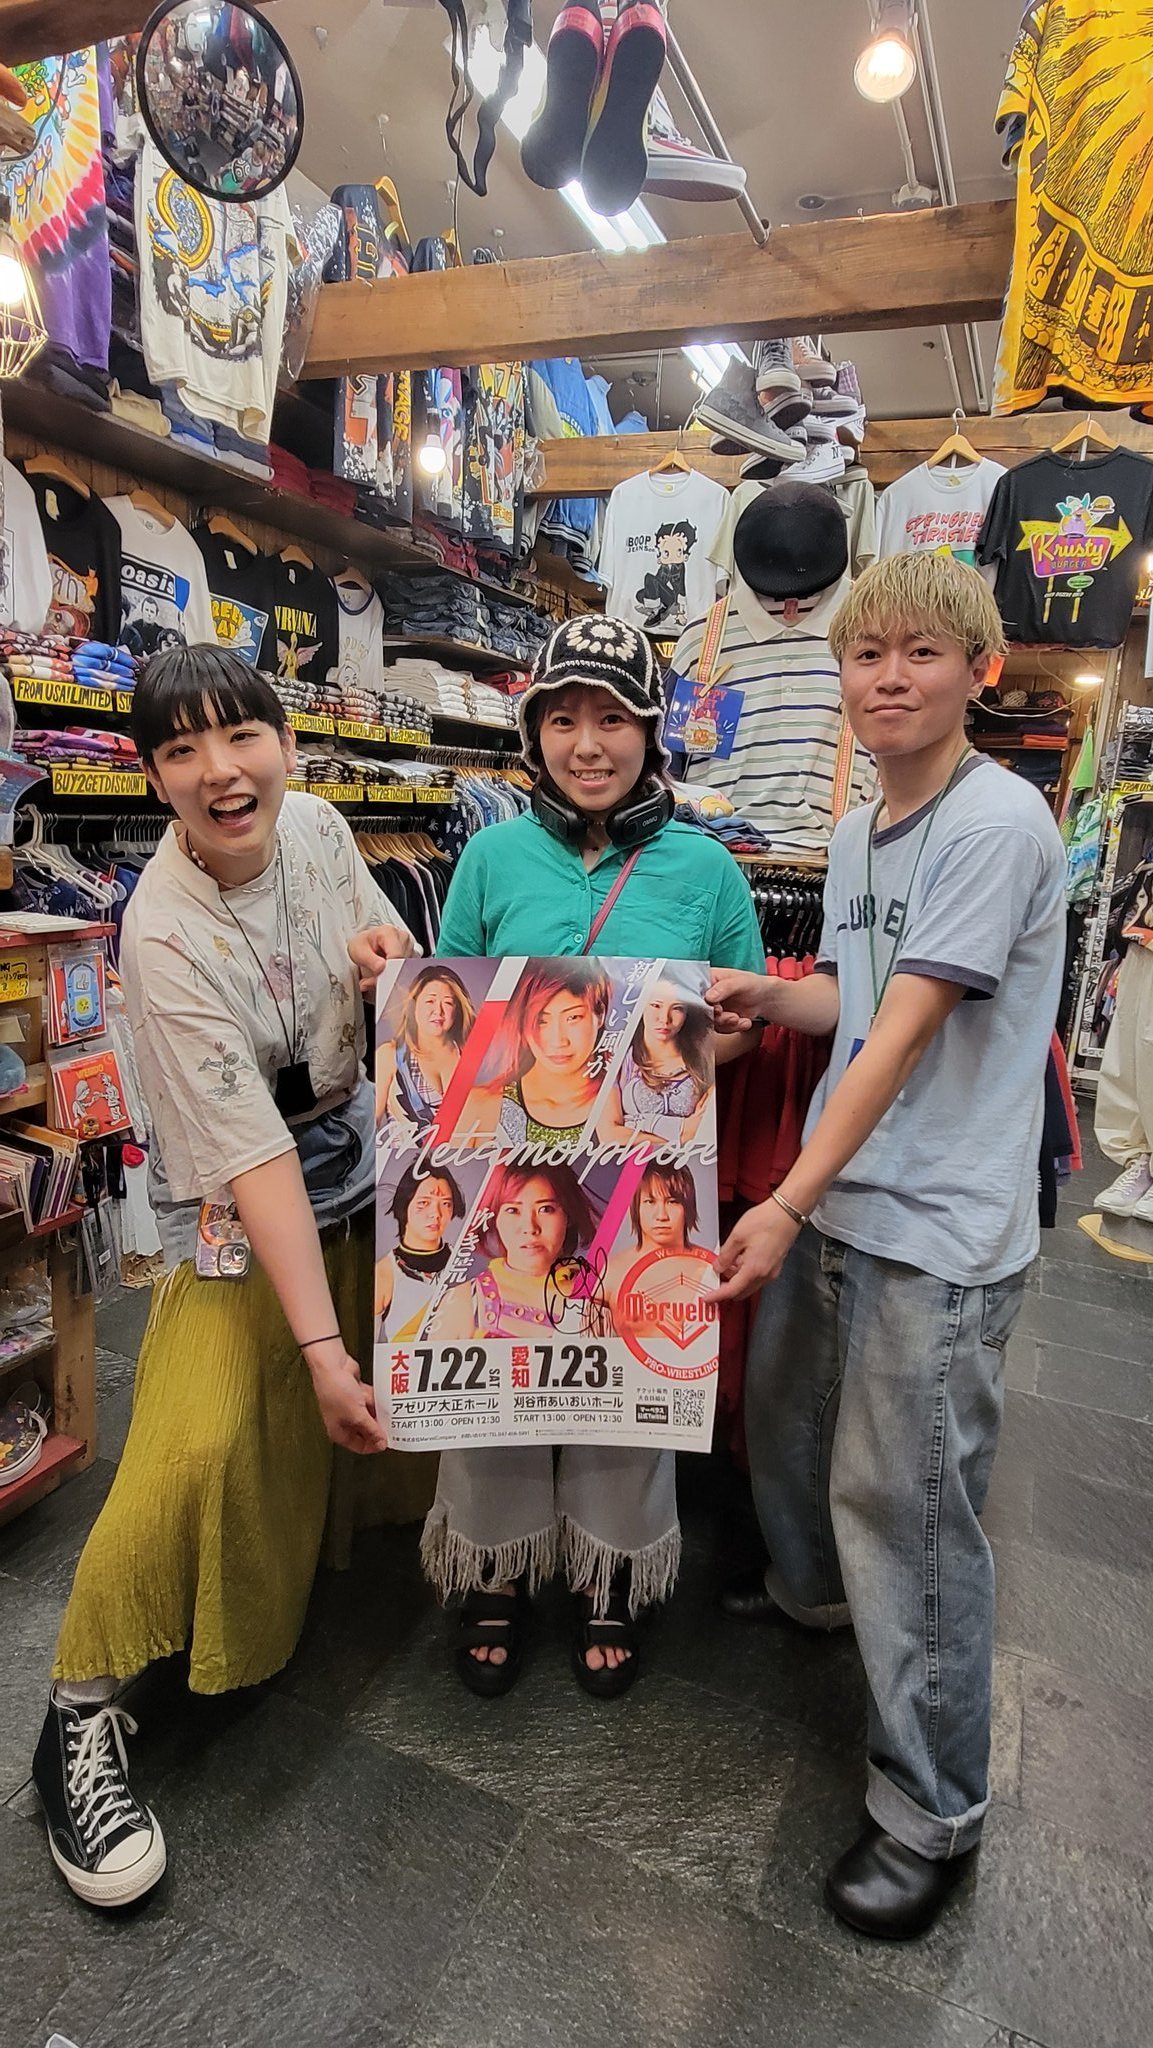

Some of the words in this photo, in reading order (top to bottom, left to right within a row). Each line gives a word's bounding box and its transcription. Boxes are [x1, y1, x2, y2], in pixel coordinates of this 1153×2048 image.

[905, 511, 985, 534] SPRINGFIEL
[628, 535, 651, 547] BOOP
[1032, 531, 1104, 566] Krusty
[1051, 560, 1088, 569] BURGER
[120, 564, 175, 594] oasis
[17, 680, 43, 700] FROM
[693, 685, 727, 701] HPPY
[376, 1119, 718, 1185] Metamorphose
[391, 1350, 409, 1395] 大阪
[414, 1346, 487, 1393] 7.22
[489, 1368, 500, 1388] SAT
[511, 1346, 529, 1388] 愛知
[534, 1345, 608, 1388] 7.23
[612, 1366, 623, 1387] SUN
[392, 1398, 499, 1415] アゼリア大正ホール
[513, 1395, 624, 1408] 刈谷市あいおいホール
[391, 1421, 417, 1429] START
[451, 1417, 474, 1426] OPEN
[476, 1416, 500, 1425] 12:30
[513, 1415, 539, 1423] START
[573, 1414, 596, 1422] OPEN
[597, 1415, 622, 1423] 12:30
